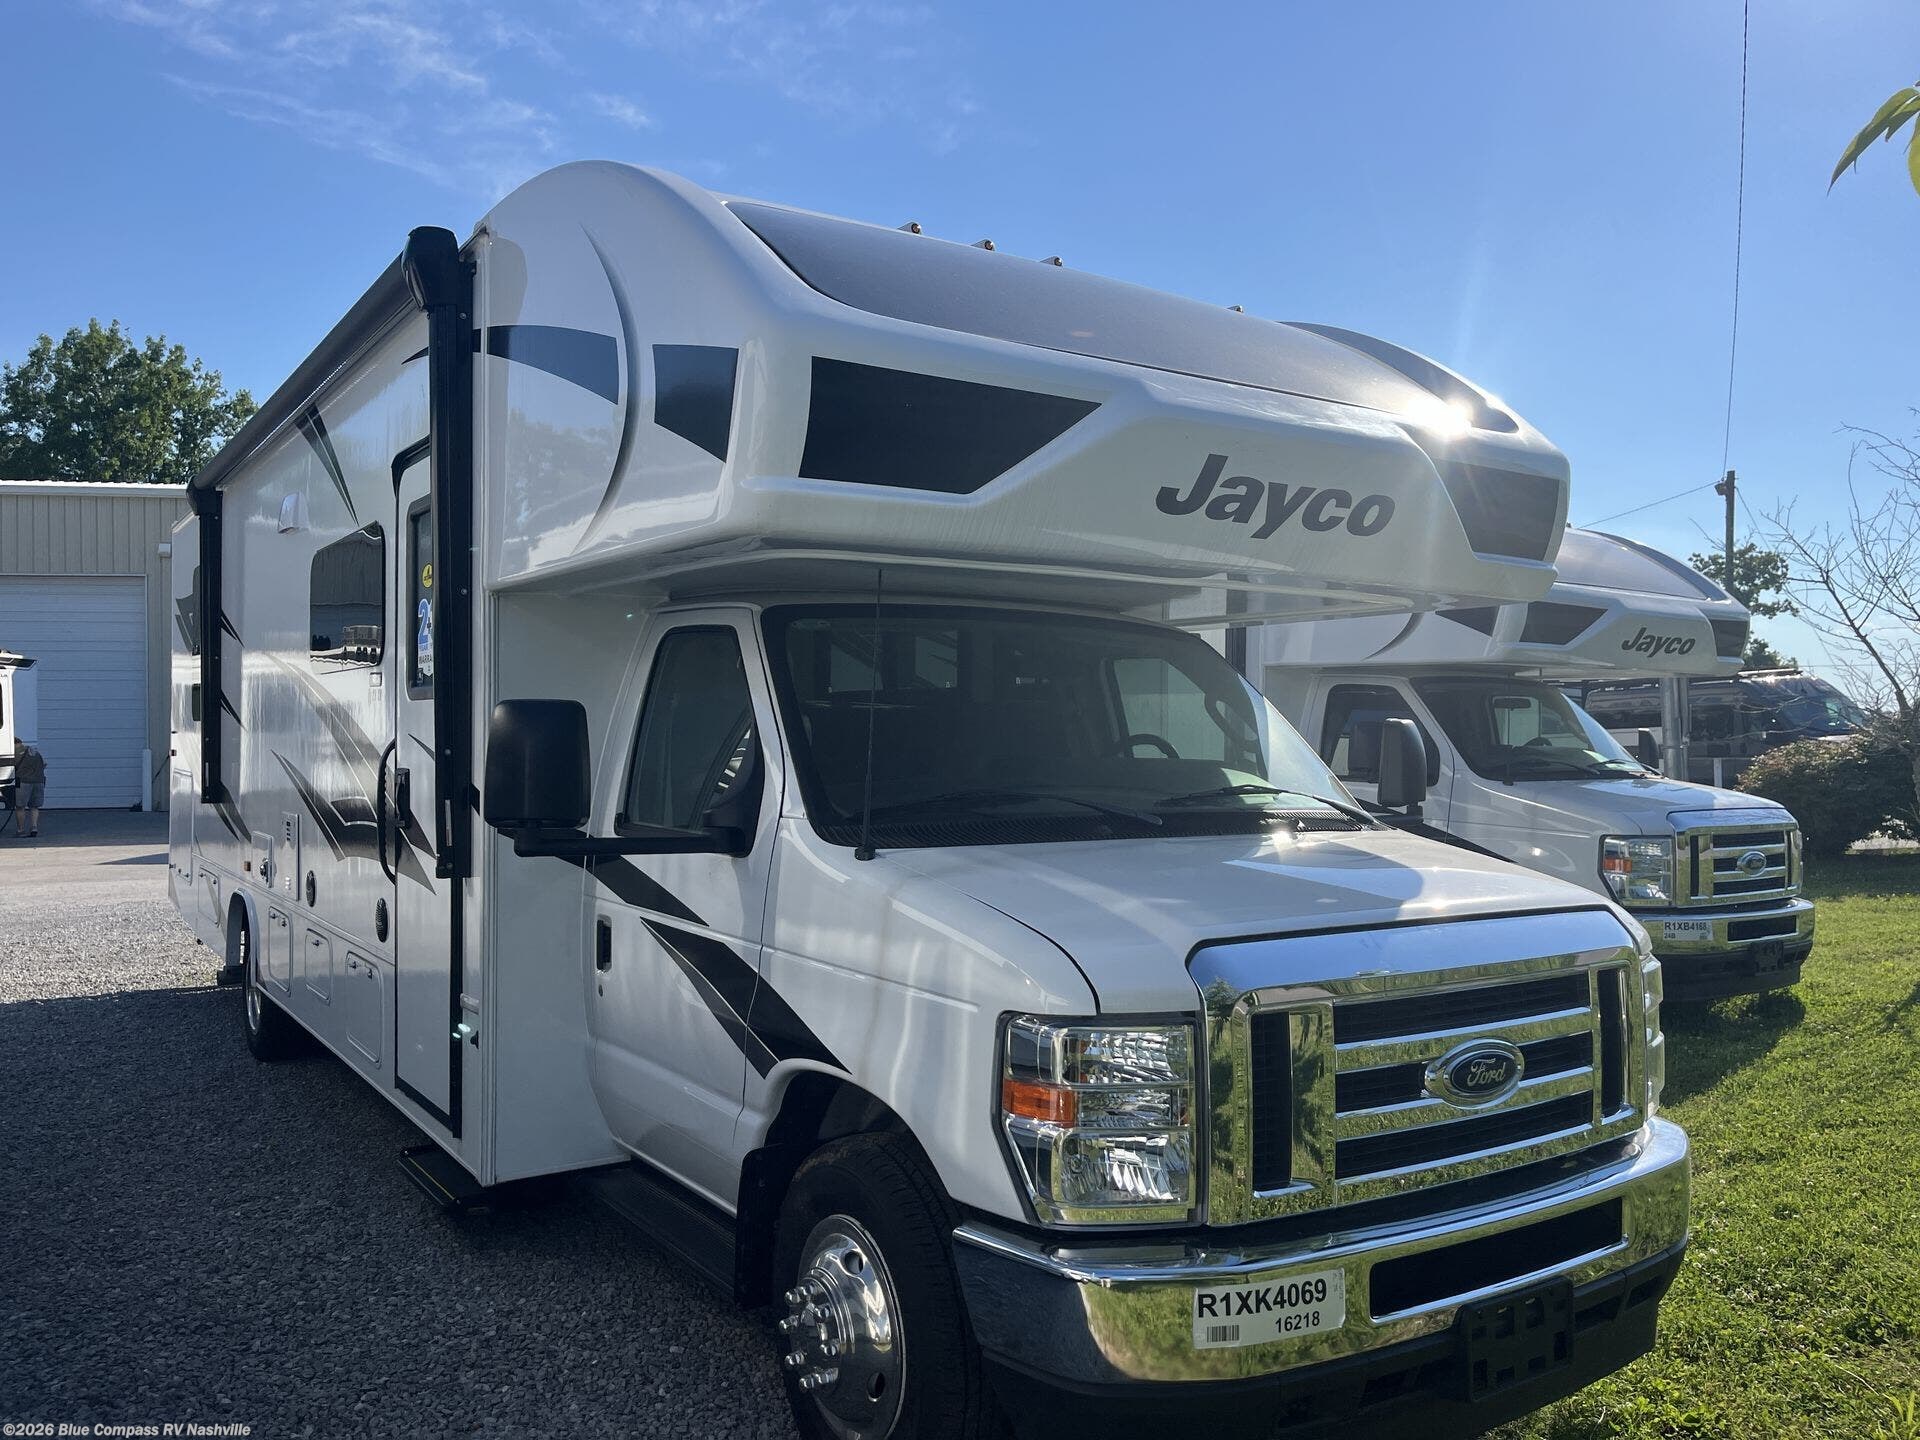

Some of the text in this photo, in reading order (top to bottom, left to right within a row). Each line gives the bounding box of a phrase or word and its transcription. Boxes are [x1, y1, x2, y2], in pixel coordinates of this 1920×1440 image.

[1155, 453, 1396, 540] Jayco
[1621, 627, 1696, 658] Jayco
[1467, 1057, 1506, 1087] Ford
[1197, 1278, 1327, 1318] R1XK4069
[1275, 1310, 1320, 1333] 16218
